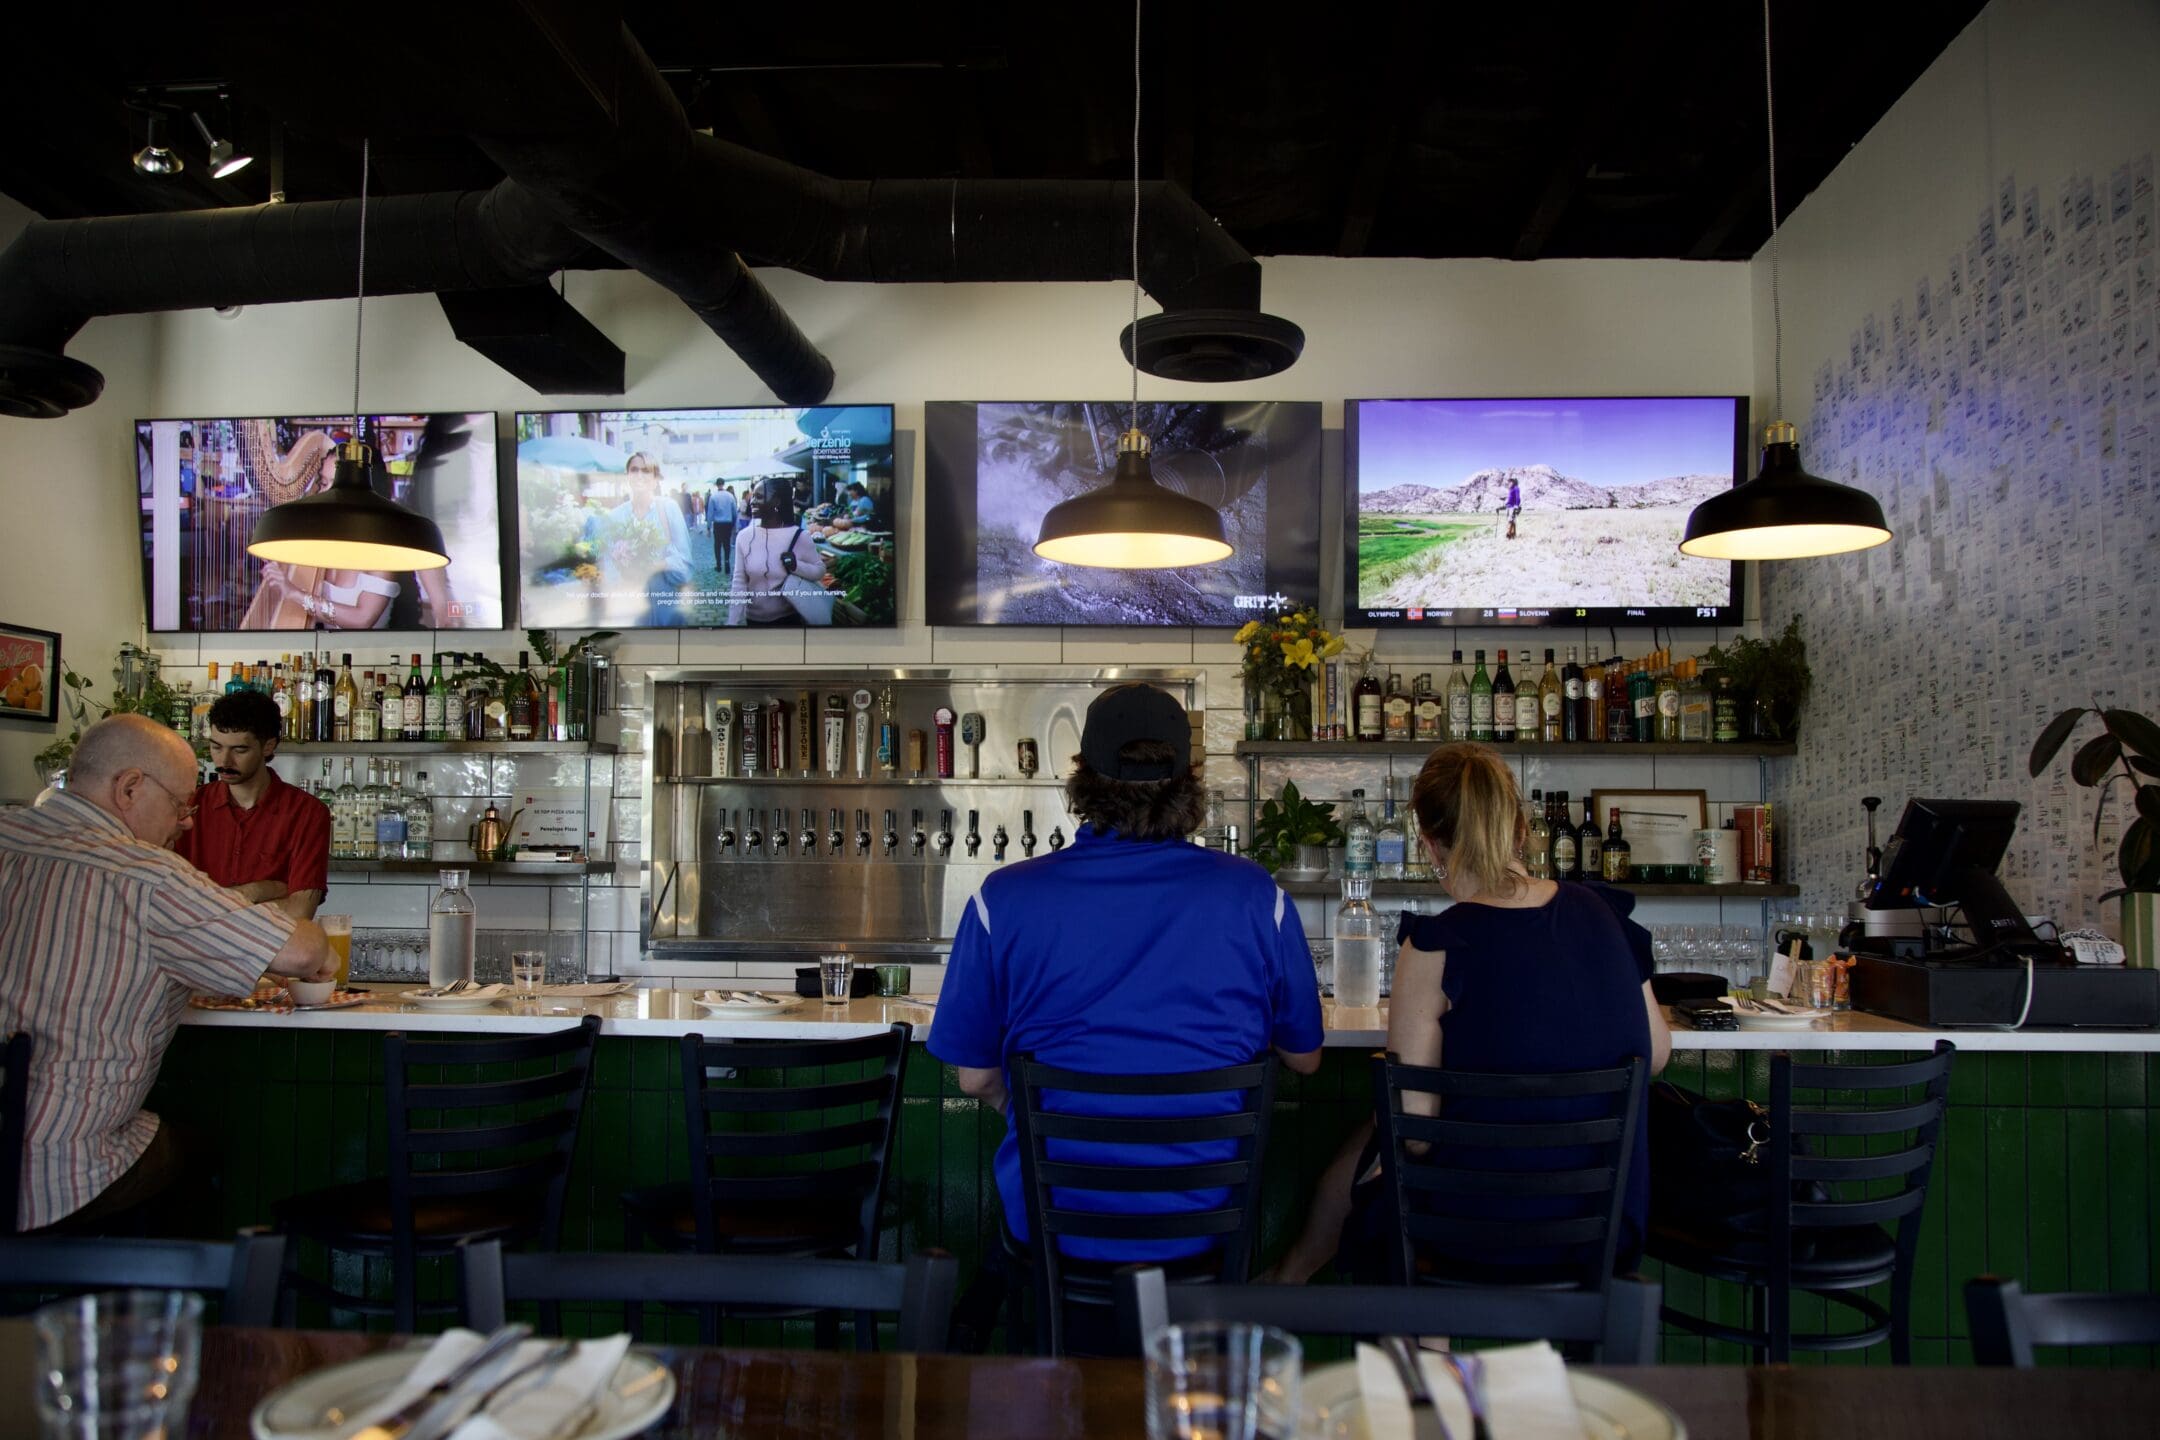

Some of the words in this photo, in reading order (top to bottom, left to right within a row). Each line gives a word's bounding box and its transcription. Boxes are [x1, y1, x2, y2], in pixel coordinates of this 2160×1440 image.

[755, 591, 767, 599] you
[800, 591, 811, 599] you
[1233, 595, 1267, 608] GRIT
[1576, 609, 1587, 617] 33
[1696, 607, 1717, 617] FS1
